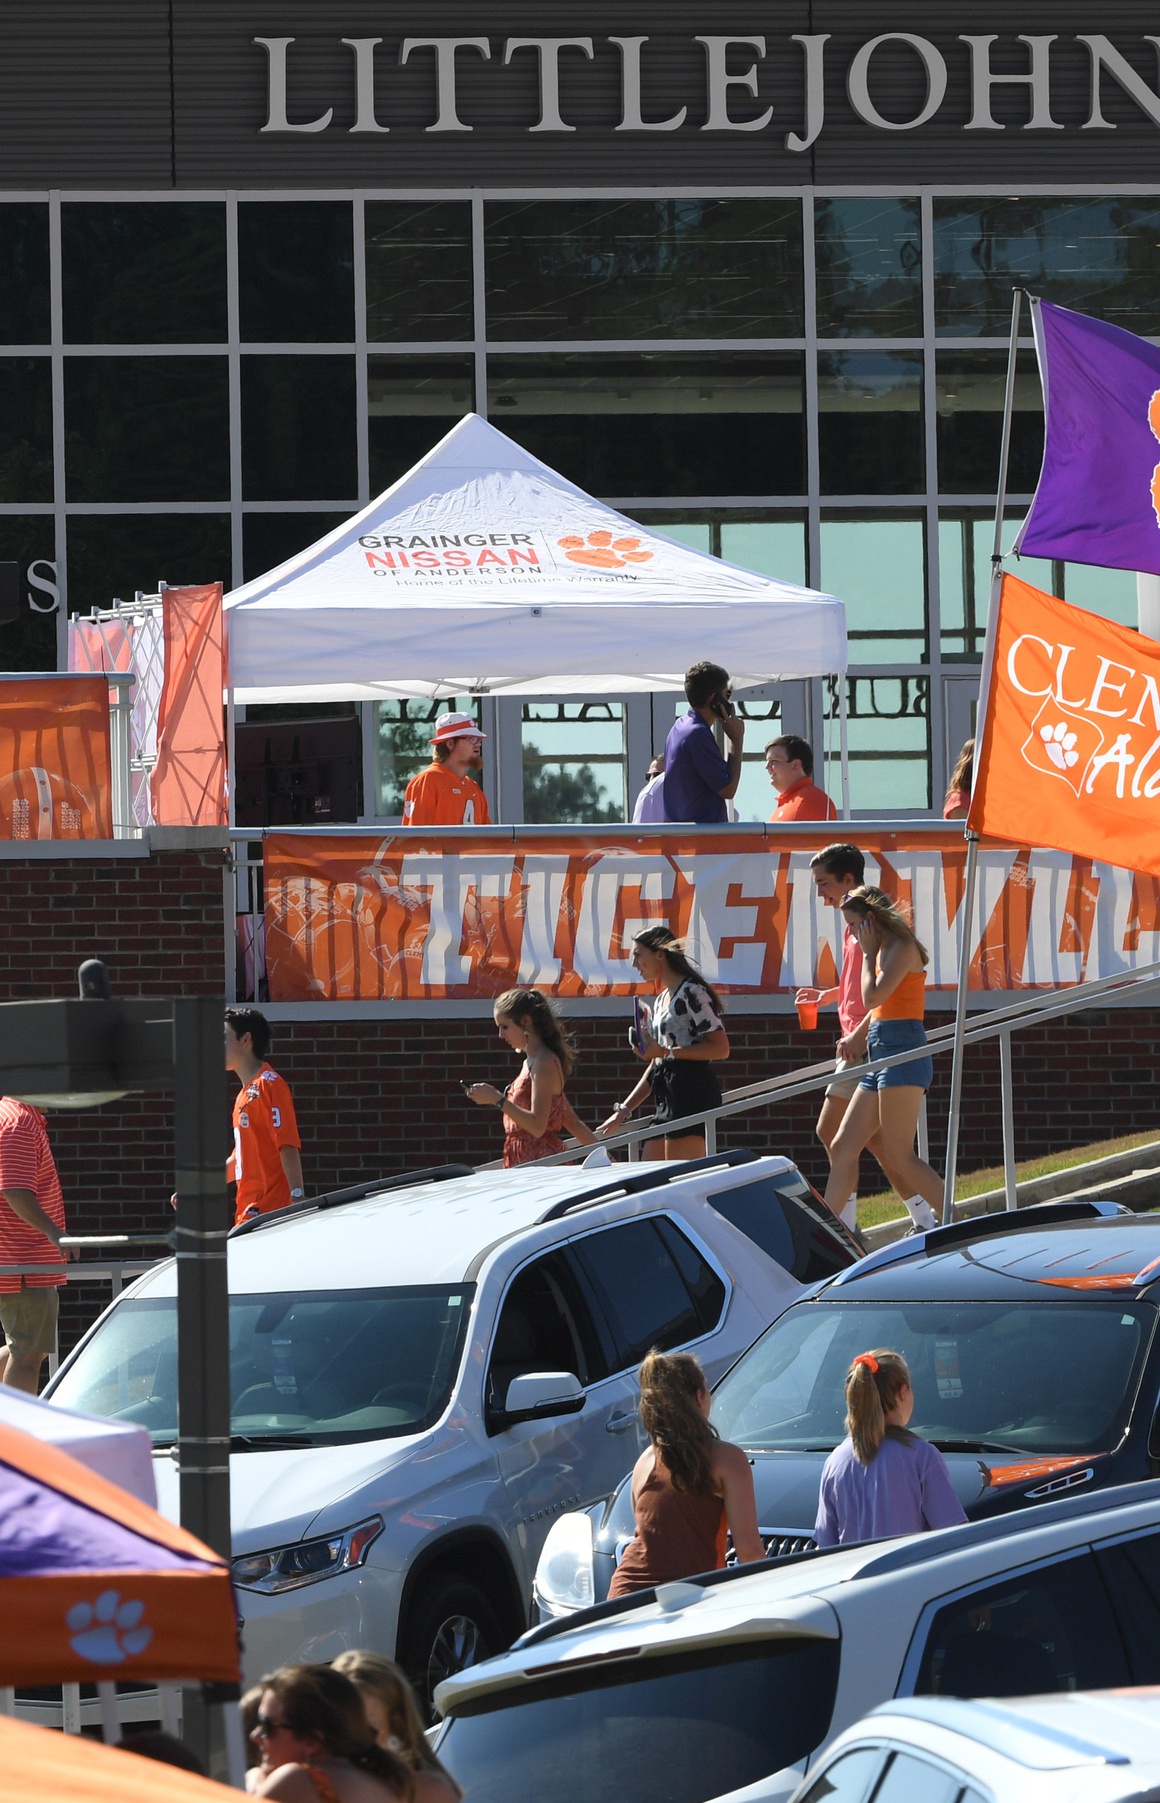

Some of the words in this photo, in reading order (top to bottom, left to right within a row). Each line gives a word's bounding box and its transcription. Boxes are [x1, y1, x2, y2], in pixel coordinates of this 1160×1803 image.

[358, 532, 535, 549] GRAINGER
[365, 547, 540, 569] NISSAN
[373, 568, 401, 578] OF
[414, 565, 542, 577] ANDERSON
[396, 578, 444, 587] Home
[449, 577, 464, 586] of
[469, 577, 494, 586] the
[566, 571, 638, 584] Warranty
